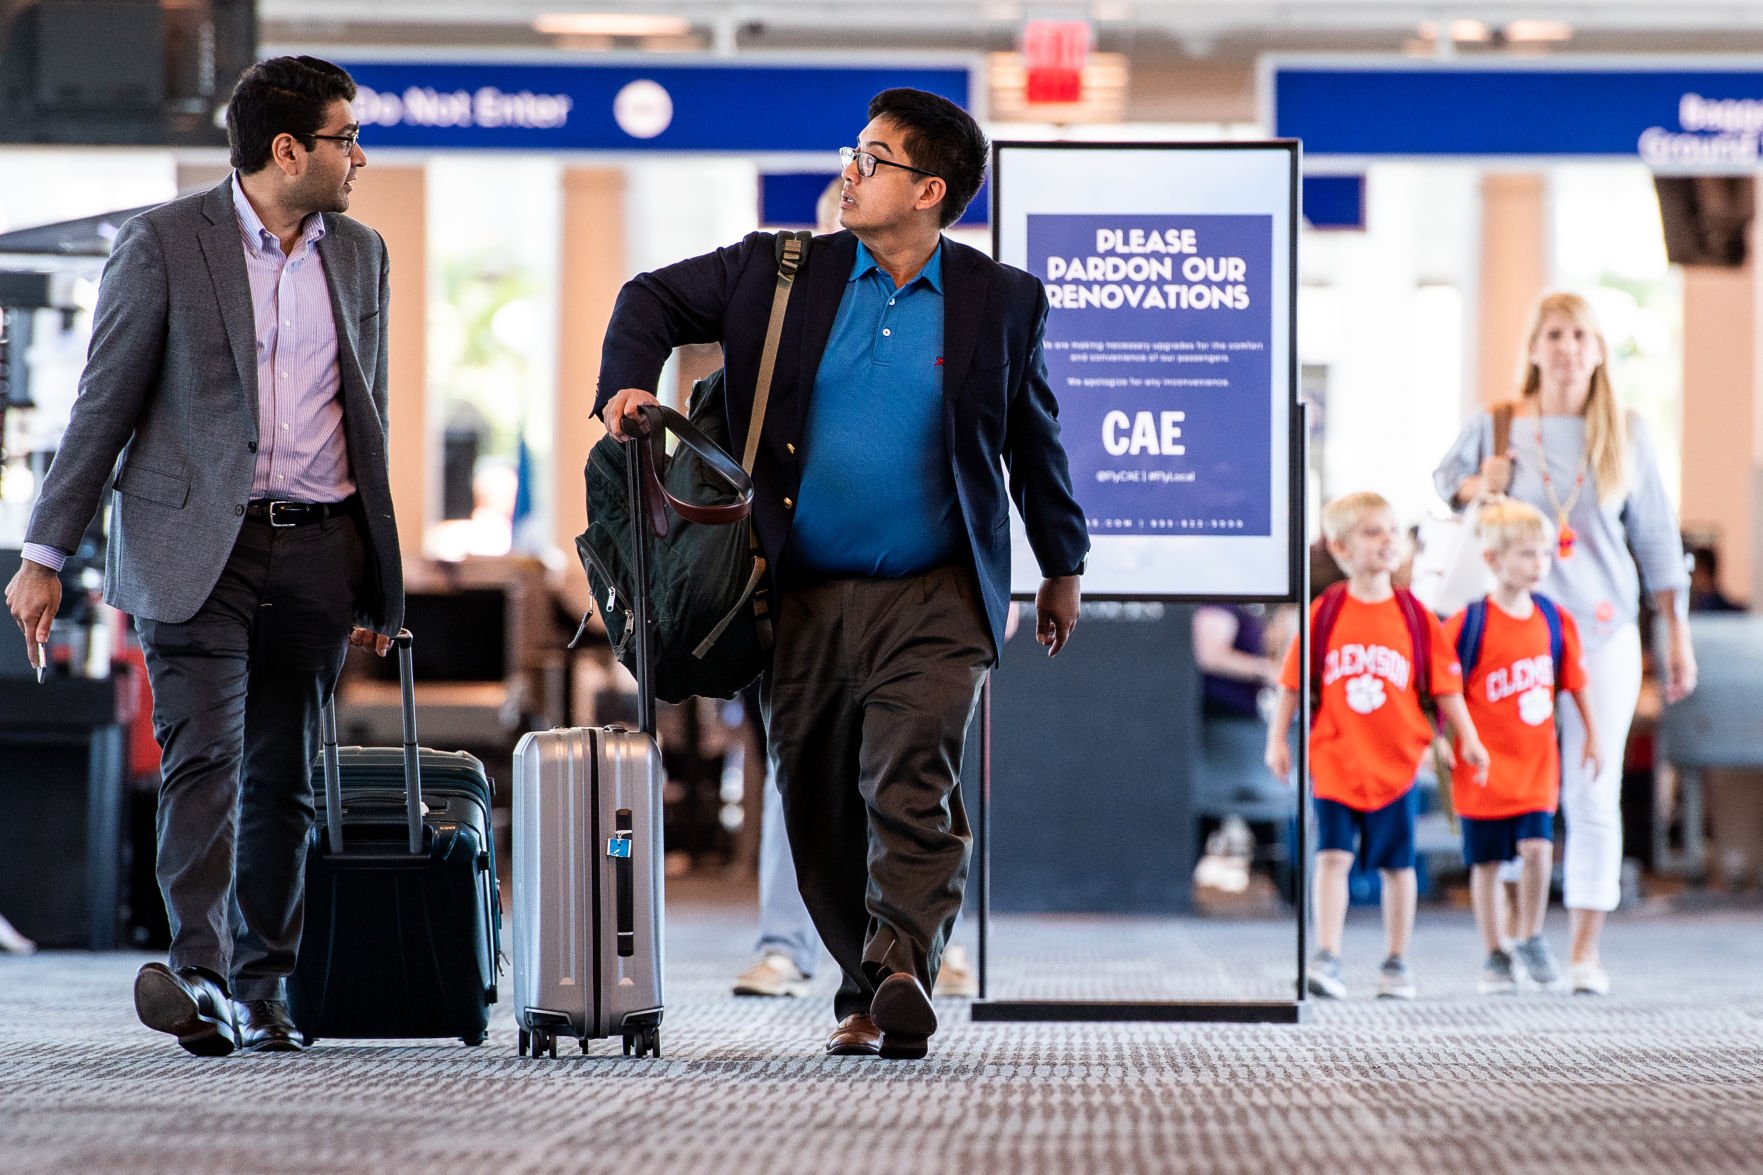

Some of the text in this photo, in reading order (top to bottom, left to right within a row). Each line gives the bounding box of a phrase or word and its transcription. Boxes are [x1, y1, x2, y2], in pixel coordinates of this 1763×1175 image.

[402, 85, 472, 128] Not
[473, 86, 574, 128] Enter
[1096, 229, 1198, 254] PLEASE
[1047, 257, 1247, 282] PARDON OUR
[1046, 284, 1250, 310] RENOVATIONS
[1066, 377, 1082, 386] We
[1102, 410, 1186, 456] CAE
